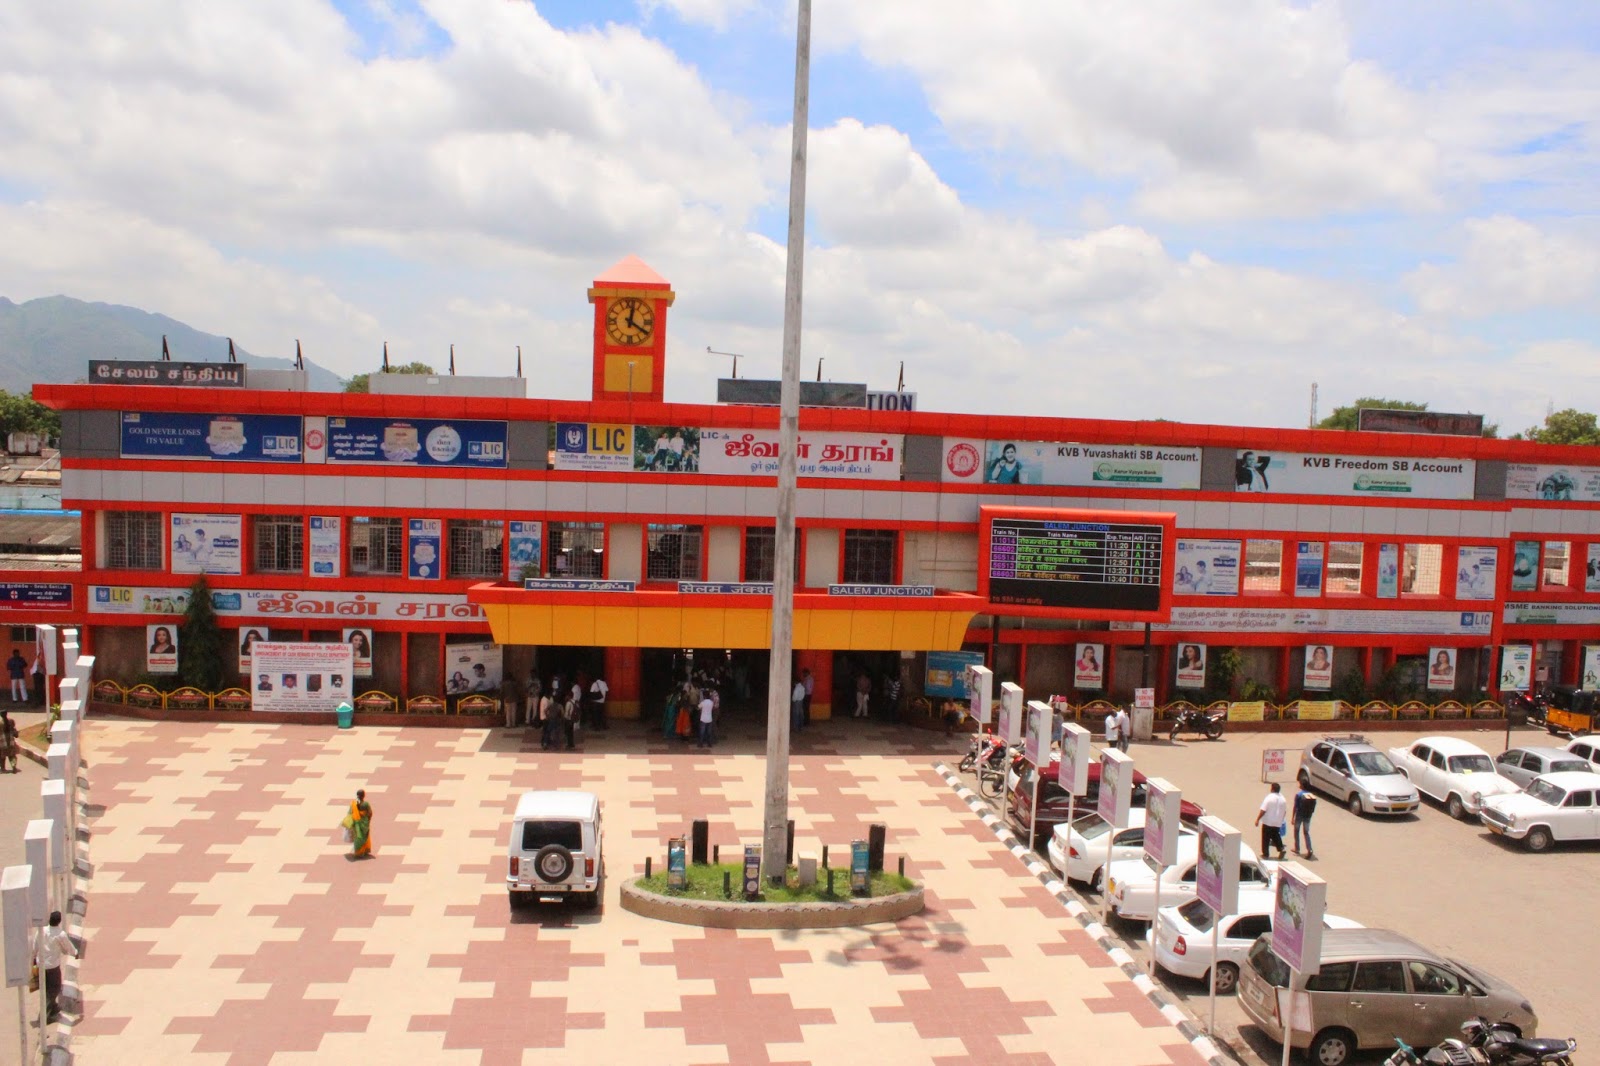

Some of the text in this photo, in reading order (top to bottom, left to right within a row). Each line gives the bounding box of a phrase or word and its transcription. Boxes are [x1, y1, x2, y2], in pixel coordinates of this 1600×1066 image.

[97, 364, 238, 382] சேலம் சந்திப்பு
[160, 437, 184, 445] VALUE
[278, 438, 296, 450] LIC
[592, 428, 625, 452] LIC
[484, 444, 500, 455] LIC
[1058, 447, 1198, 462] KVB Yuvashakti SB Account.
[1303, 457, 1462, 474] KVB Freedom SB Account
[324, 520, 337, 528] LIC
[424, 522, 436, 530] LIC
[524, 523, 536, 532] LIC
[579, 581, 629, 590] சந்திப்பு
[680, 583, 722, 593] सेलम
[832, 586, 932, 596] SALEM JUNCTION
[113, 590, 130, 602] LIC
[258, 592, 381, 615] ஜீவன்
[1475, 614, 1490, 626] LIC
